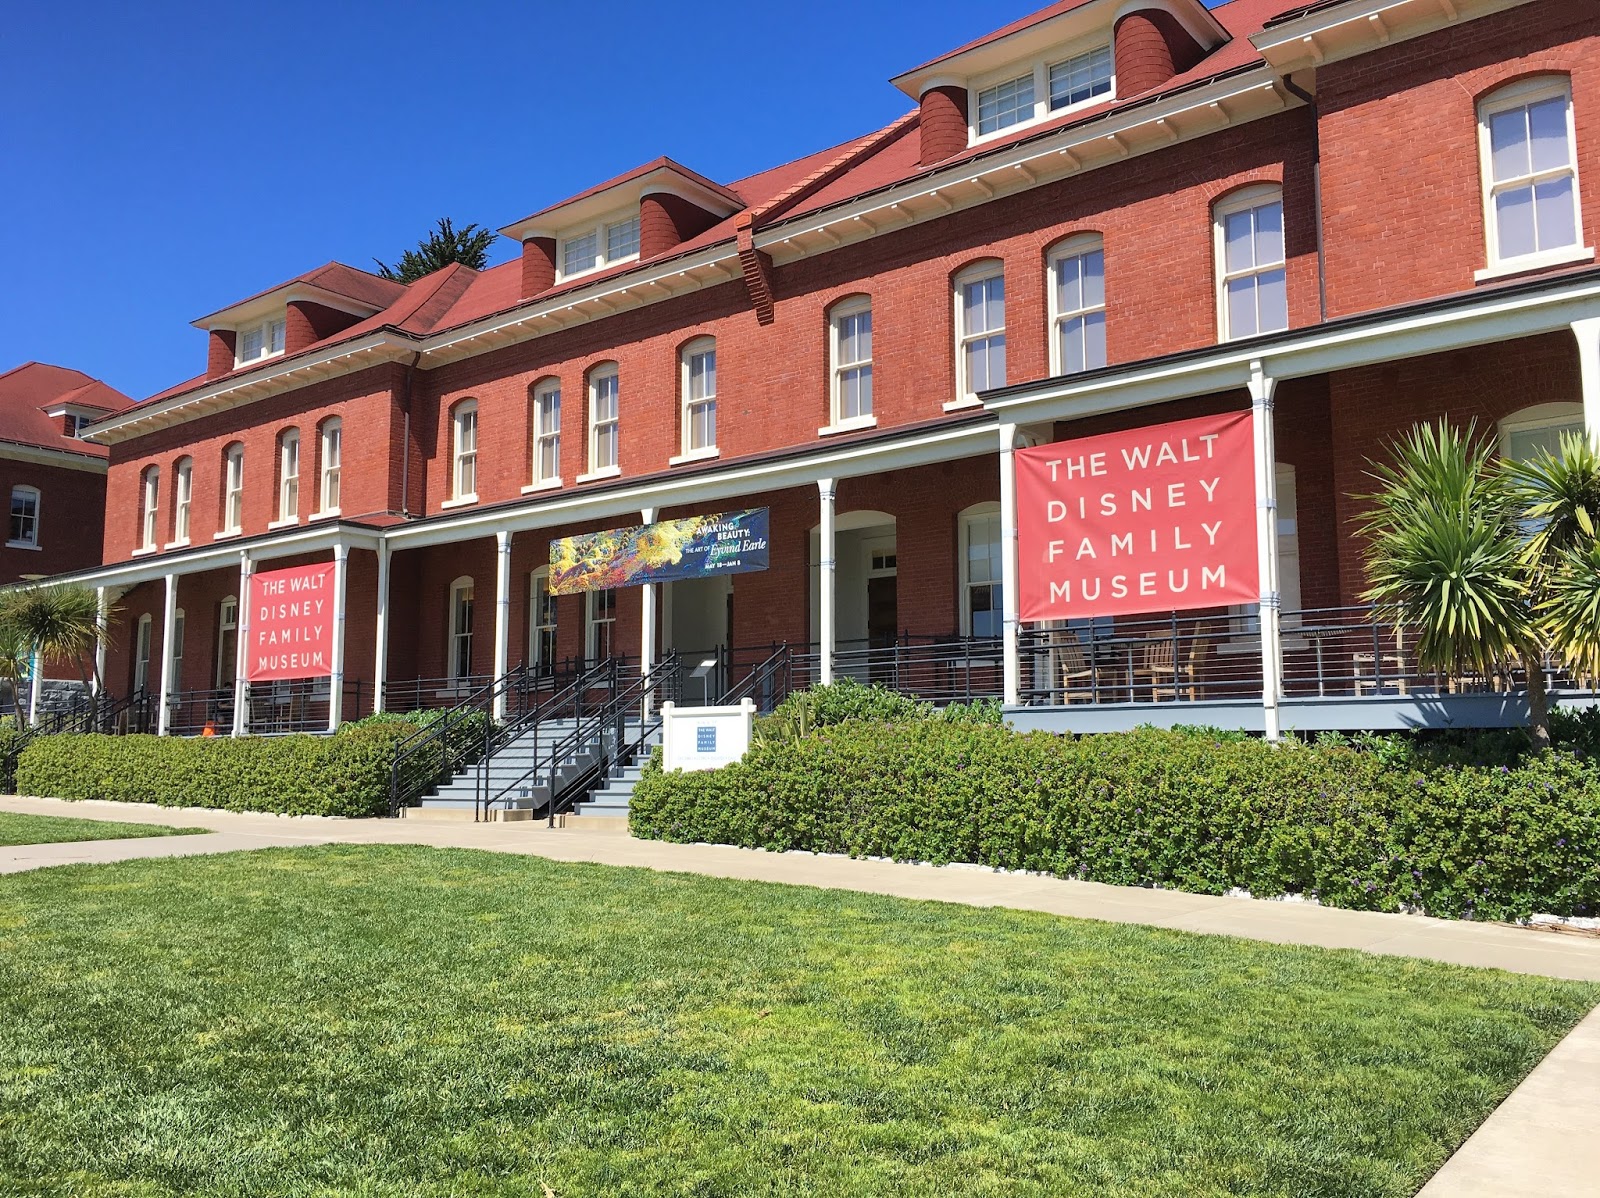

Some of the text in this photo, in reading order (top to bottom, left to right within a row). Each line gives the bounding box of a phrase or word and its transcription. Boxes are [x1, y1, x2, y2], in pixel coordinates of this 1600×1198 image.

[1046, 434, 1219, 482] THE WALT
[1047, 477, 1220, 523] DISNEY
[696, 522, 734, 535] AWAKING
[717, 529, 751, 541] BEAUTY:
[710, 541, 741, 558] Eyvind
[742, 538, 767, 552] Earle
[1048, 521, 1222, 563] FAMILY
[263, 573, 325, 596] THE WALT
[1050, 564, 1226, 604] MUSEUM
[260, 599, 324, 621] DISNEY
[259, 625, 322, 646] FAMILY
[259, 651, 323, 670] MUSEUM
